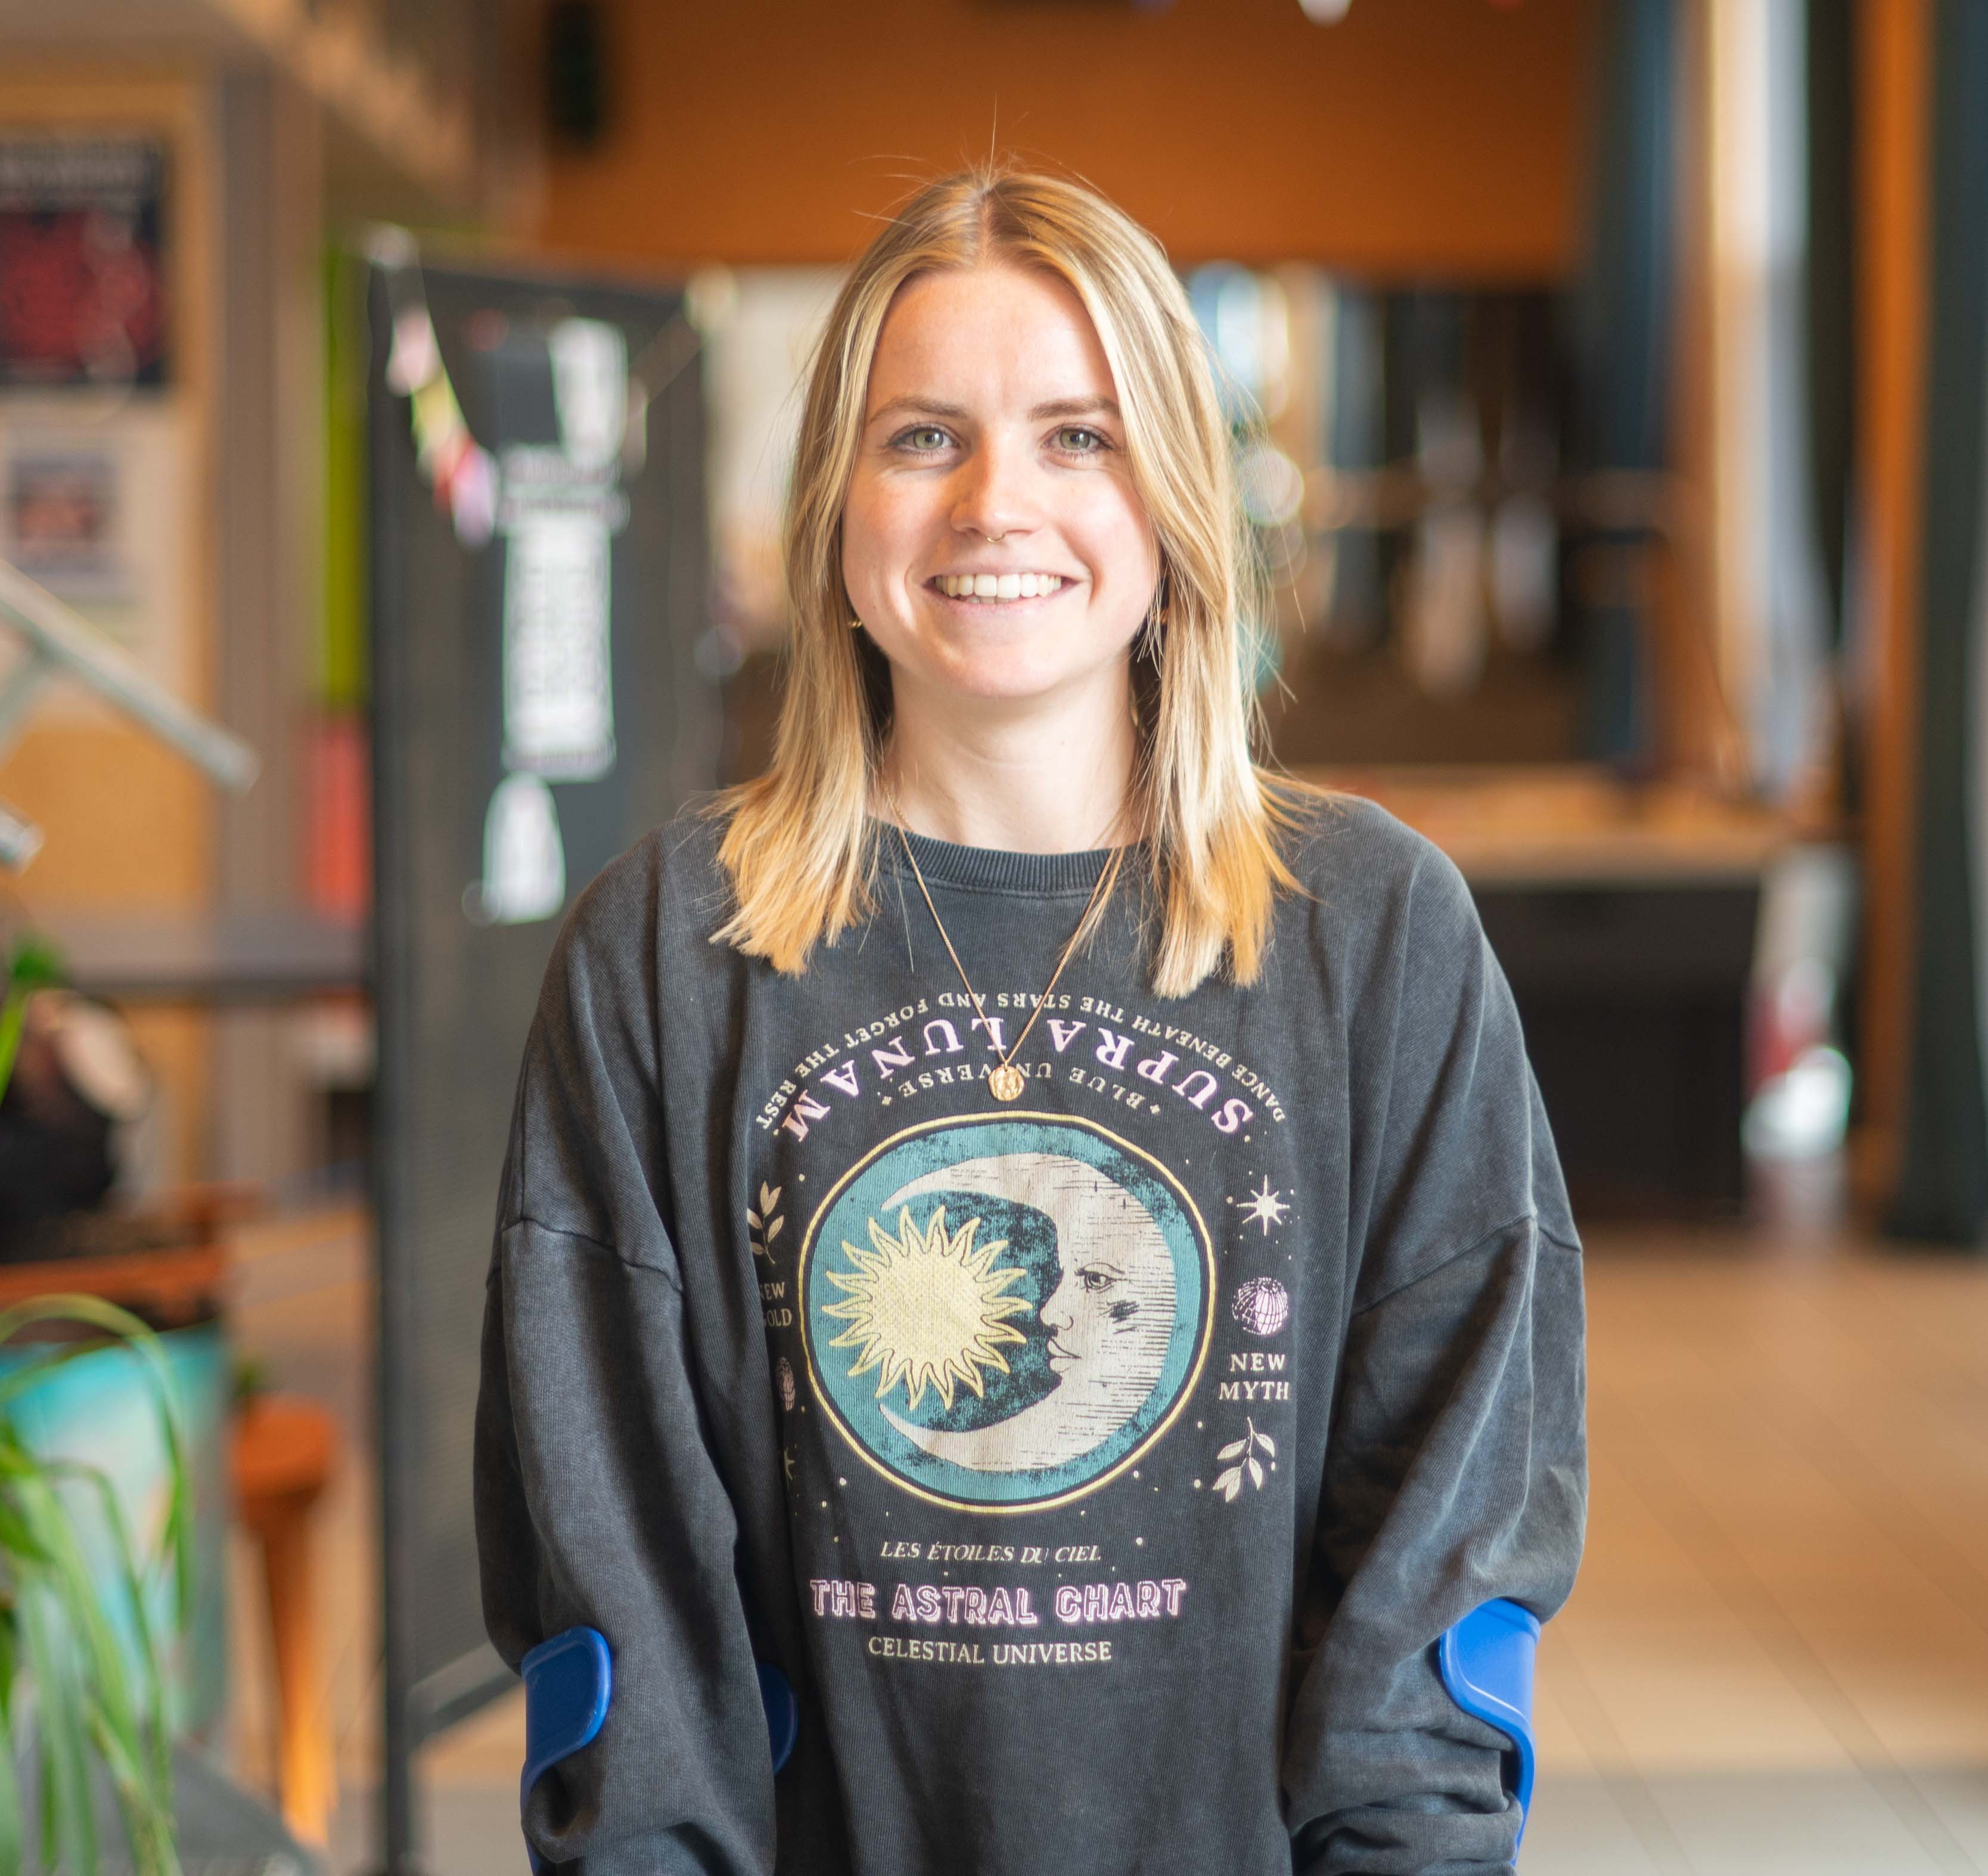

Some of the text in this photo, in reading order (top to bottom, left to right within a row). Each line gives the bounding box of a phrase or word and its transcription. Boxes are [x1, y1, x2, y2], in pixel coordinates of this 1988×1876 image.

[755, 992, 1286, 1129] DANCE BENEATH THE STARS AND FORGET THE REST
[781, 1017, 1254, 1142] SUPRA LUNAM
[897, 1062, 1145, 1110] BLUE UNVERSE
[763, 1307, 792, 1327] OLD
[1230, 1352, 1285, 1372] NEW
[1219, 1380, 1290, 1400] MYTH
[880, 1541, 1101, 1564] LES ÉTOILES DU CIEL
[810, 1578, 1186, 1625] THE ASTRAL CHART
[868, 1636, 1112, 1664] CELESTIAL UNIVERSE
